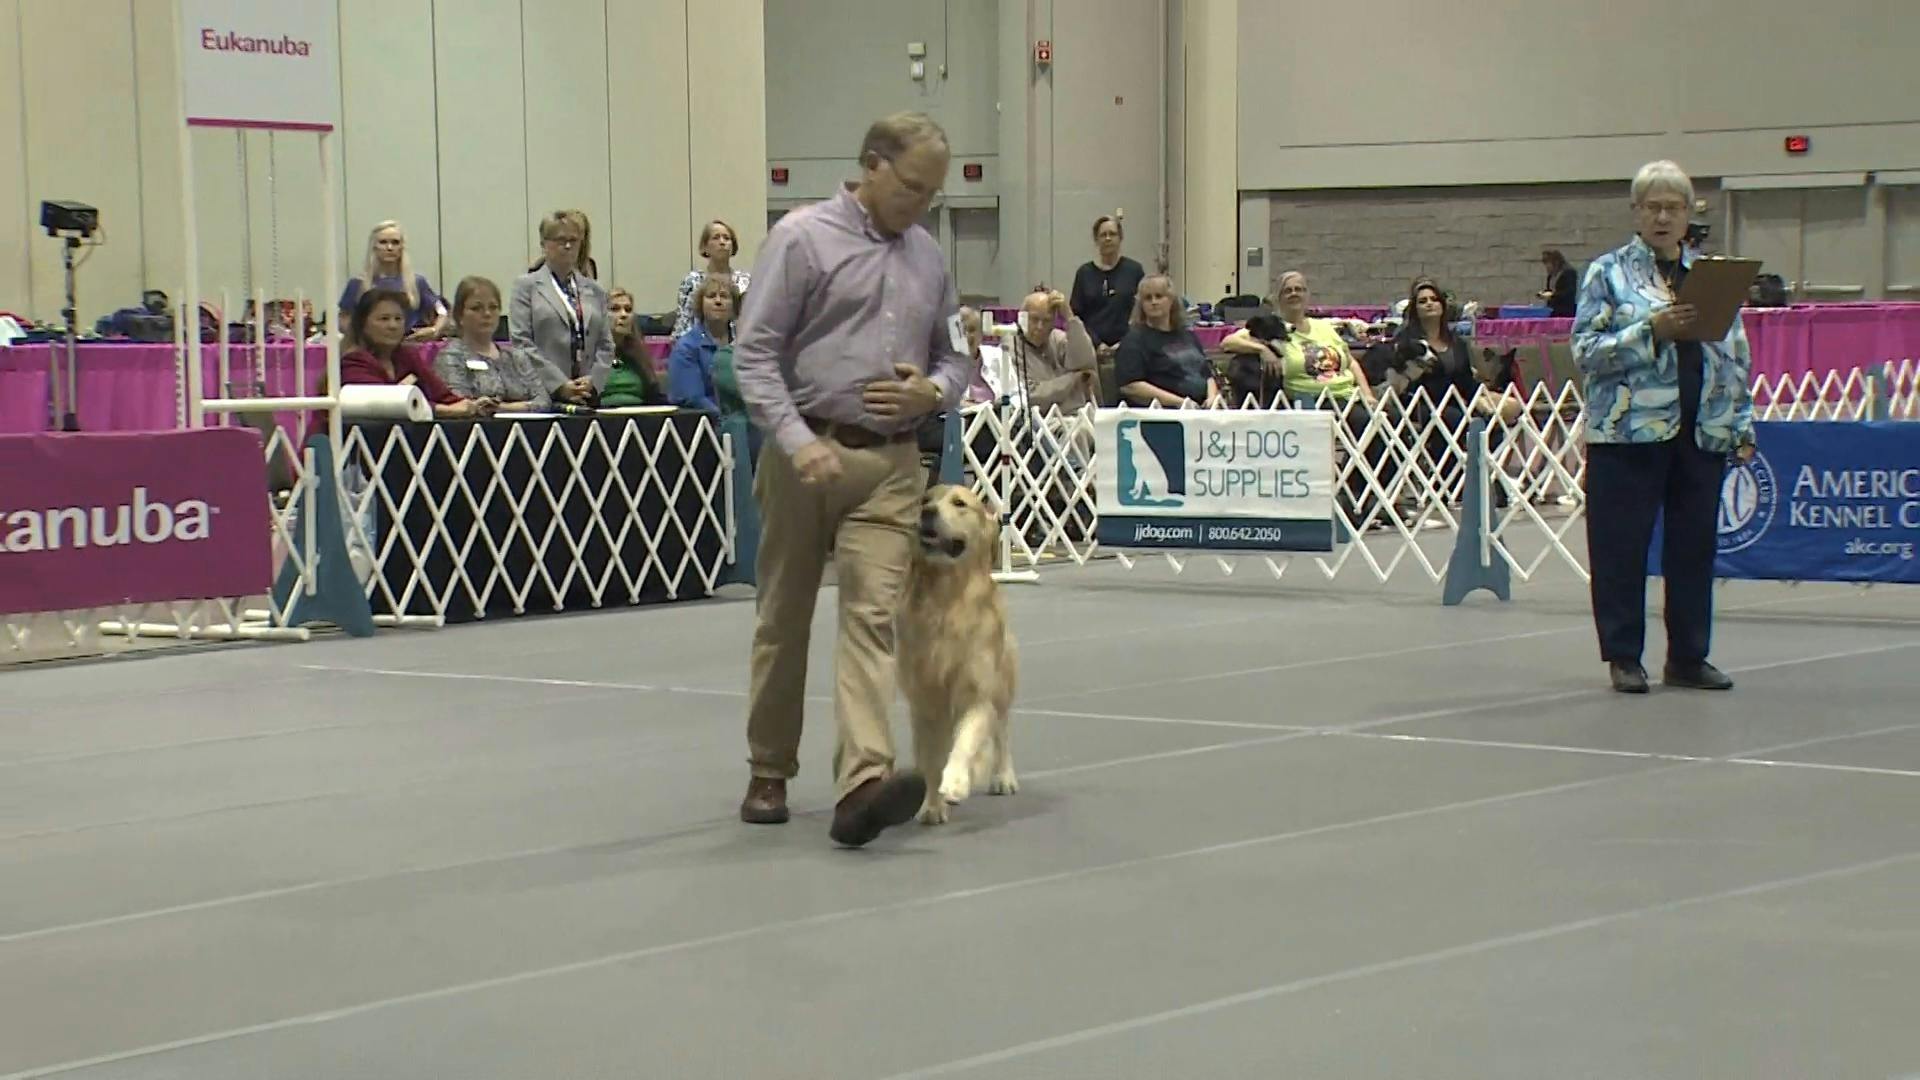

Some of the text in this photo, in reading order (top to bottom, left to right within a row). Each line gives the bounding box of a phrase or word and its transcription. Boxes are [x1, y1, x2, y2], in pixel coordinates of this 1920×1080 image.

[201, 28, 310, 56] Eukanuba
[1194, 430, 1300, 462] J&J DOG
[1193, 469, 1310, 498] SUPPLIES
[1789, 500, 1893, 529] KENNEL
[1134, 523, 1281, 542] jjdog.com 800.642.2050
[1844, 538, 1913, 559] akc.org
